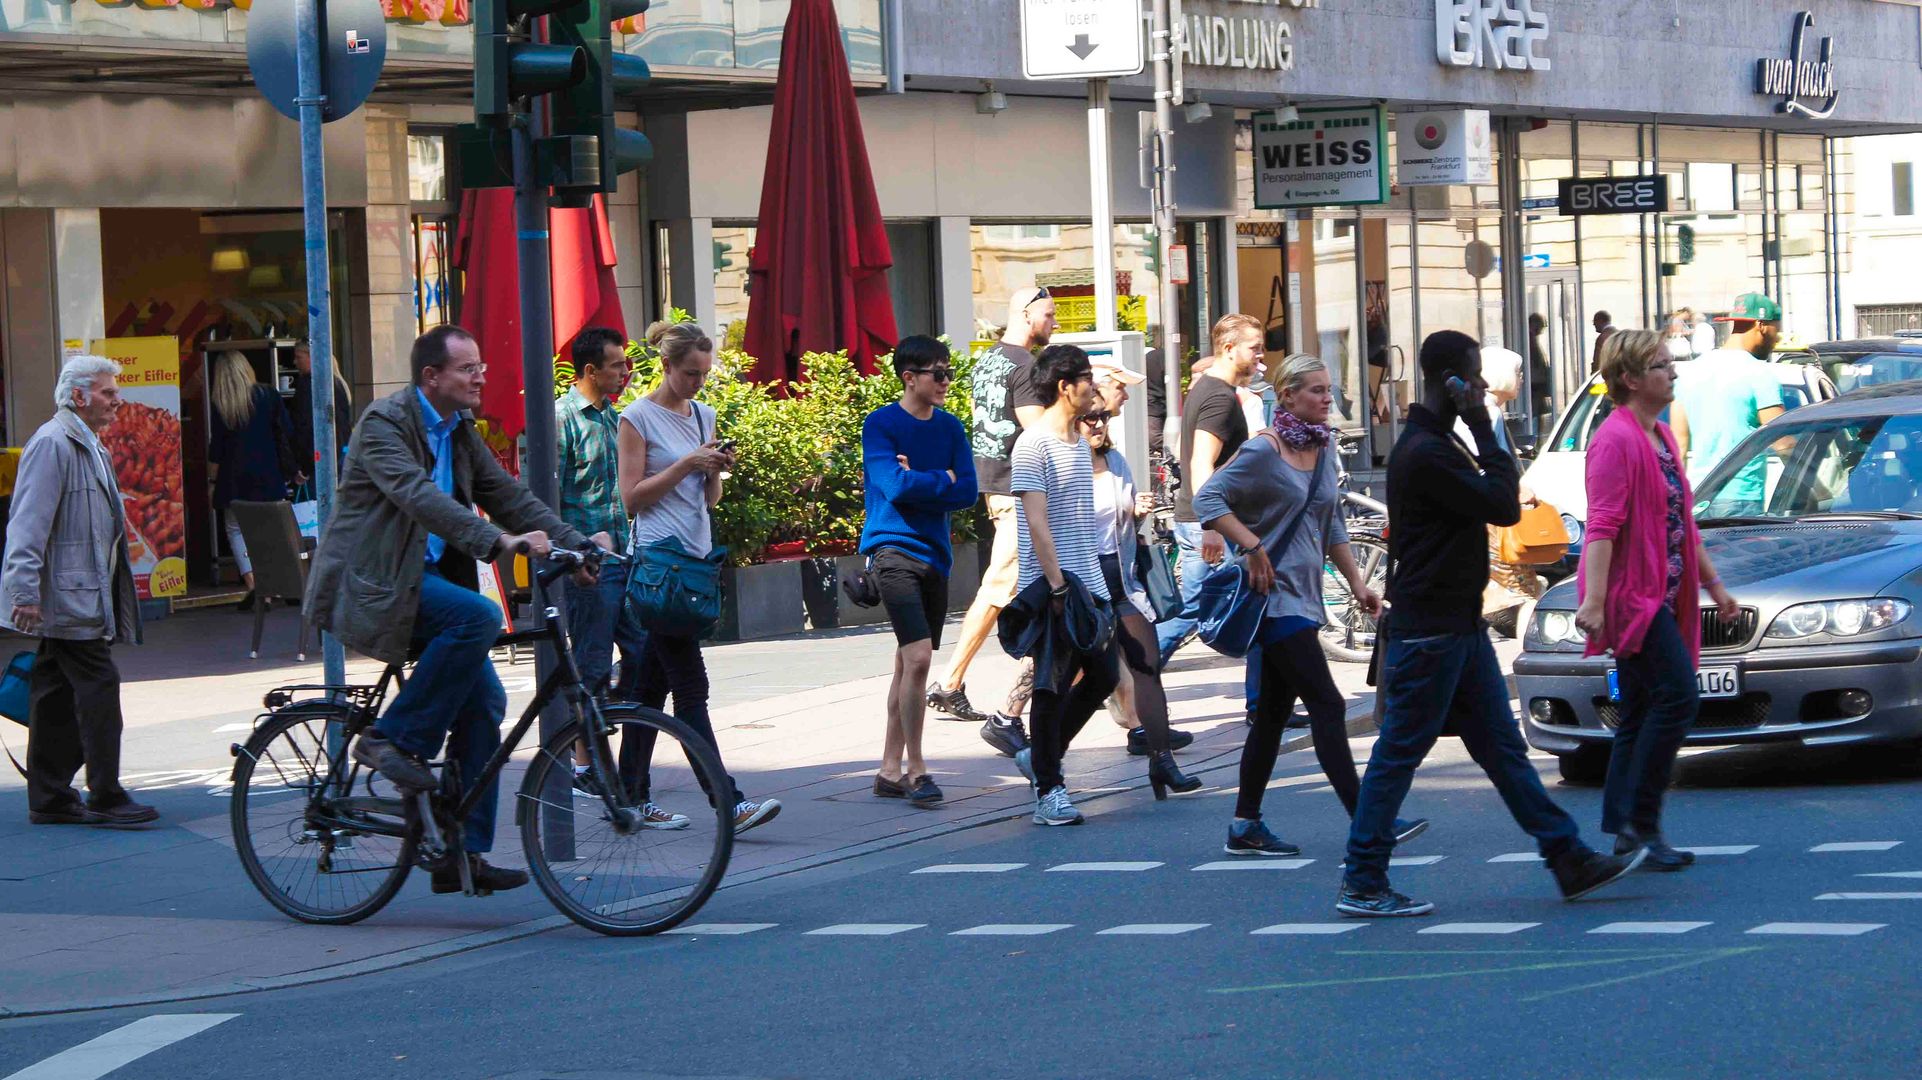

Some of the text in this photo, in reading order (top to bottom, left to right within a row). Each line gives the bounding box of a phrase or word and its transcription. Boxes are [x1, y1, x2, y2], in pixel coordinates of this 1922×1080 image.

[1436, 0, 1551, 70] BREE
[1430, 162, 1461, 171] Frankfurt
[1262, 168, 1373, 183] Personalmanagement
[1570, 180, 1655, 210] BREE
[144, 369, 178, 382] Eifler
[158, 575, 185, 593] Eifler
